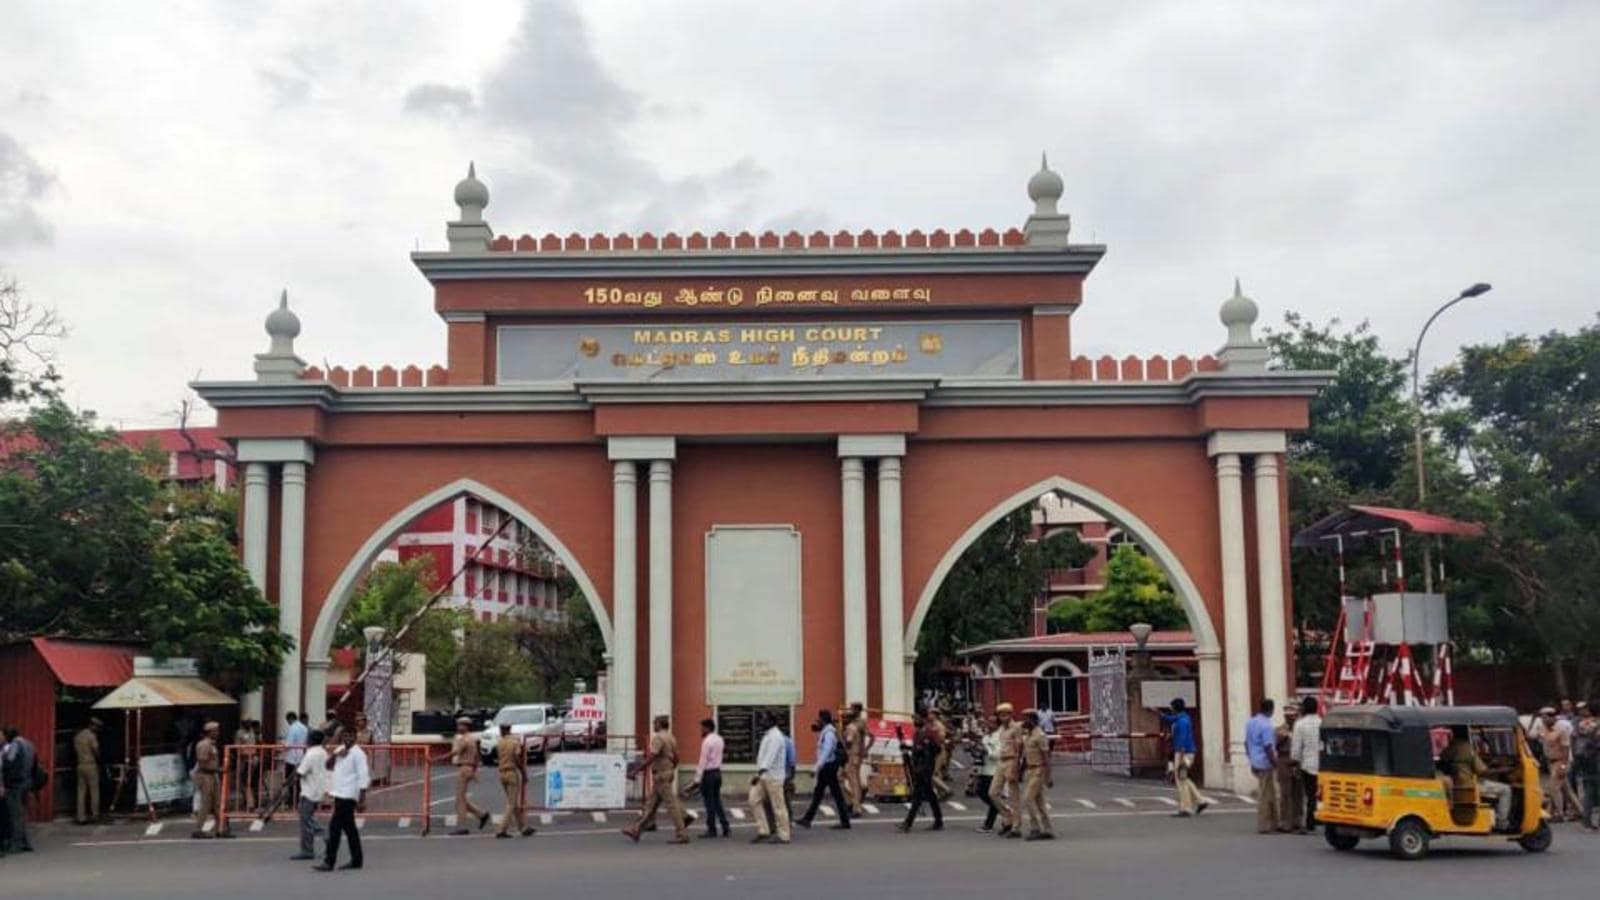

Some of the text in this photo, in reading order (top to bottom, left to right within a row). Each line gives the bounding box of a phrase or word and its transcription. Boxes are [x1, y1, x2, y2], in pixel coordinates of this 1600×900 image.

[584, 286, 931, 307] 150வது ஆண்டு நினைவு வளைவு
[634, 327, 883, 343] MADRAS HIGH COURT
[583, 697, 596, 705] NO
[574, 709, 602, 718] ENTRY
